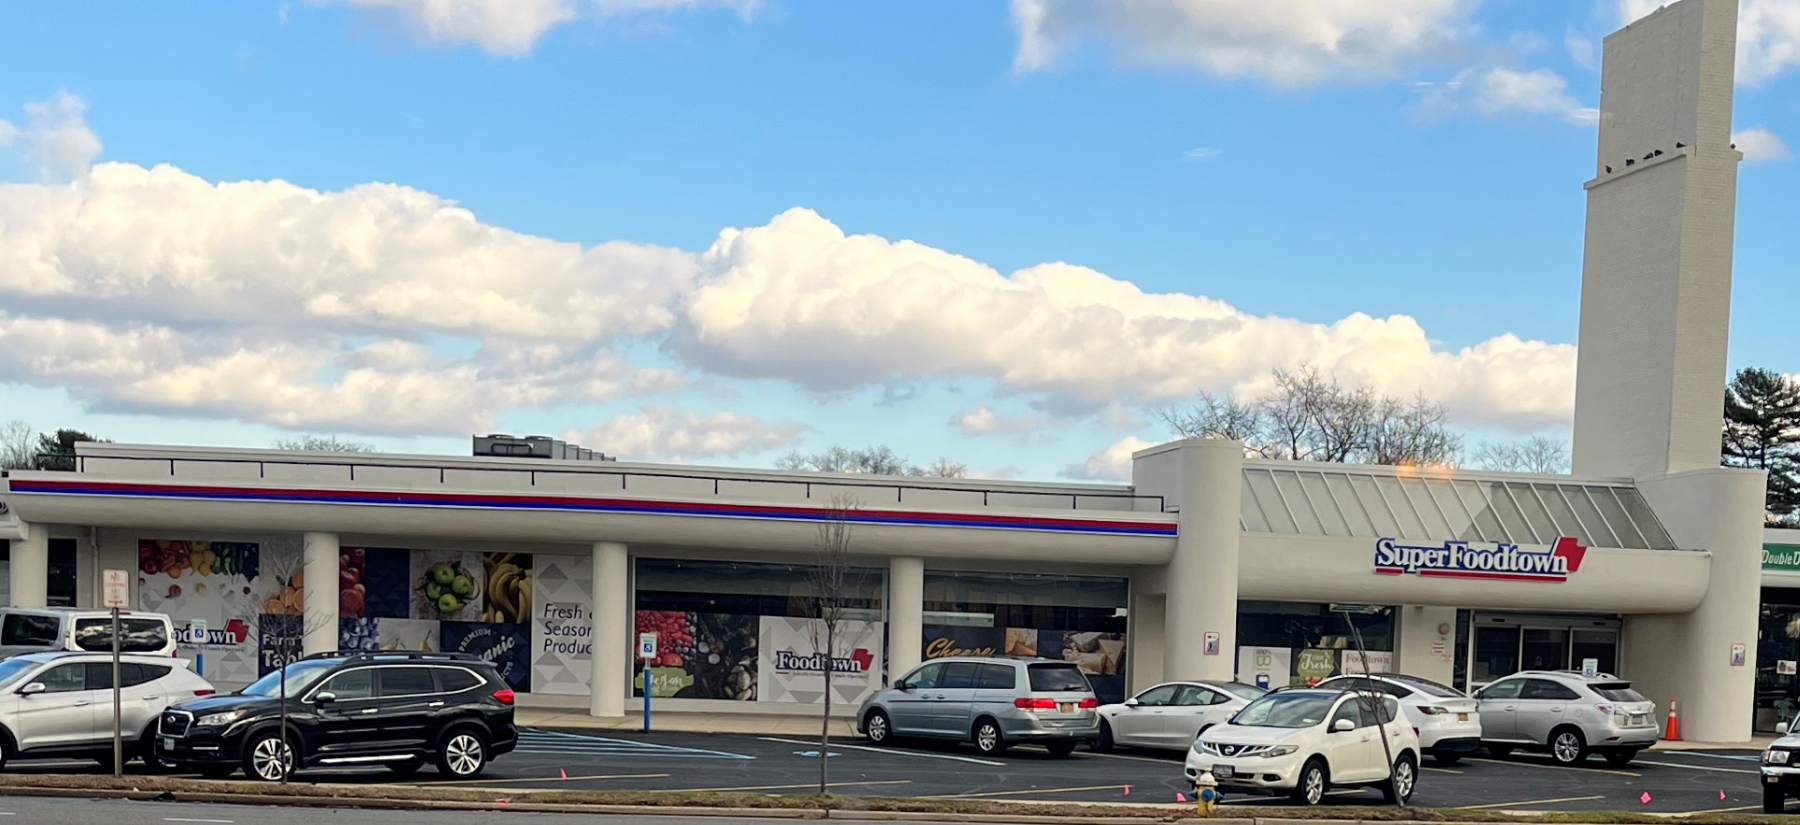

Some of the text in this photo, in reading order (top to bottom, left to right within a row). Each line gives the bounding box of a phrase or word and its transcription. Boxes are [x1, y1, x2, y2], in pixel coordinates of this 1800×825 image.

[1762, 549, 1793, 565] Double
[543, 603, 583, 619] Fresh
[262, 633, 296, 646] Farm
[458, 628, 491, 652] PREMIUM
